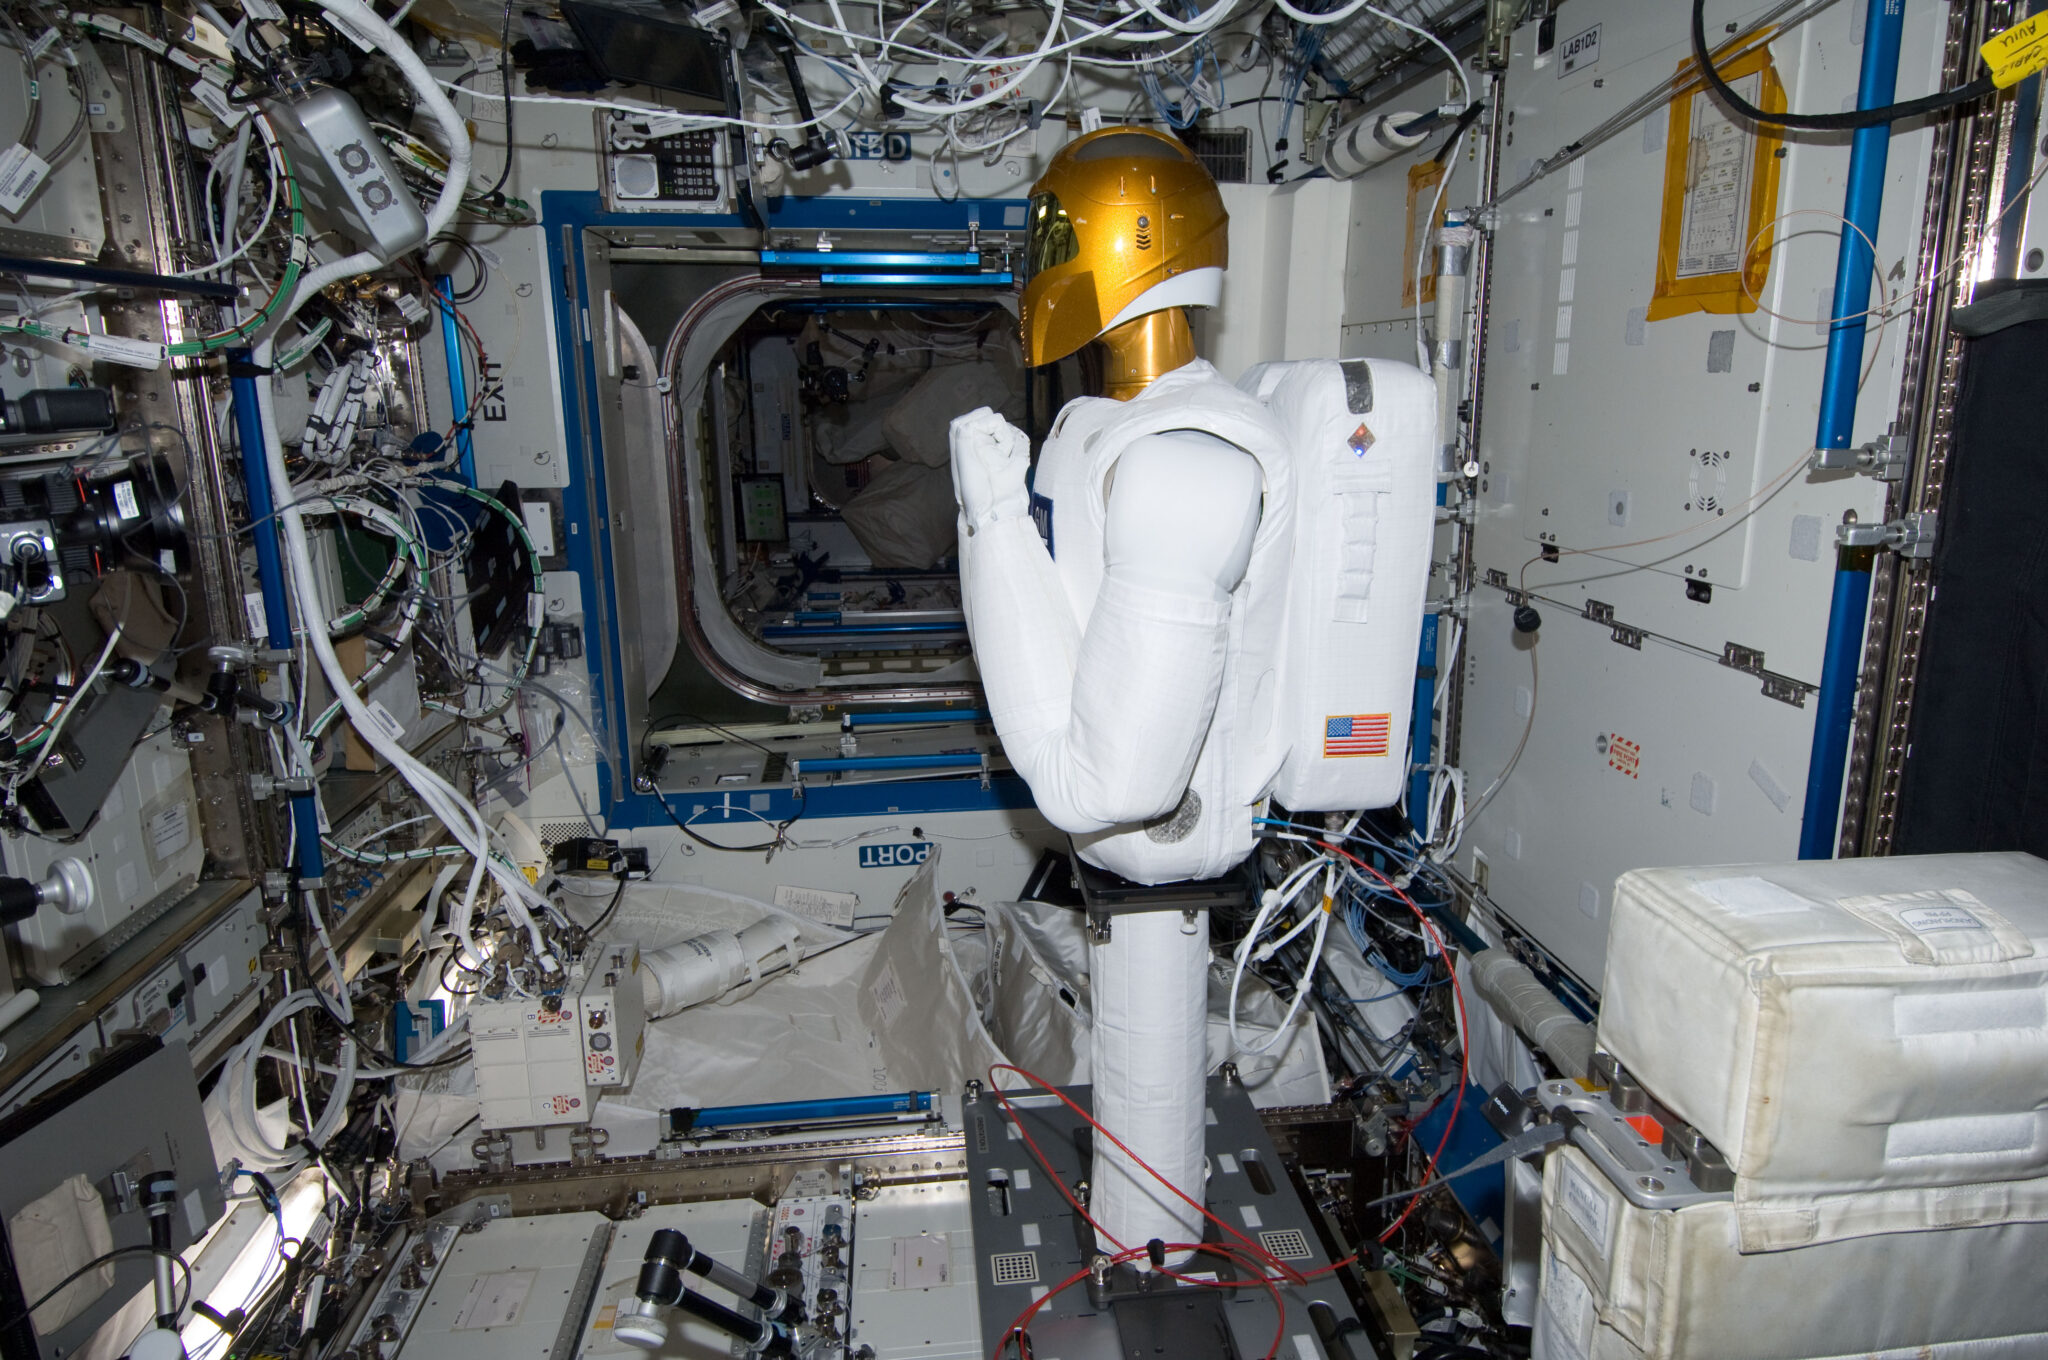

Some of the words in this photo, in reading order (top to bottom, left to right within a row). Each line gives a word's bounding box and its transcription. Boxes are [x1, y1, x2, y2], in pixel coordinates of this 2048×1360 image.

[1562, 30, 1598, 61] LAB1D2
[478, 357, 507, 422] EXIT
[861, 844, 930, 866] PORT
